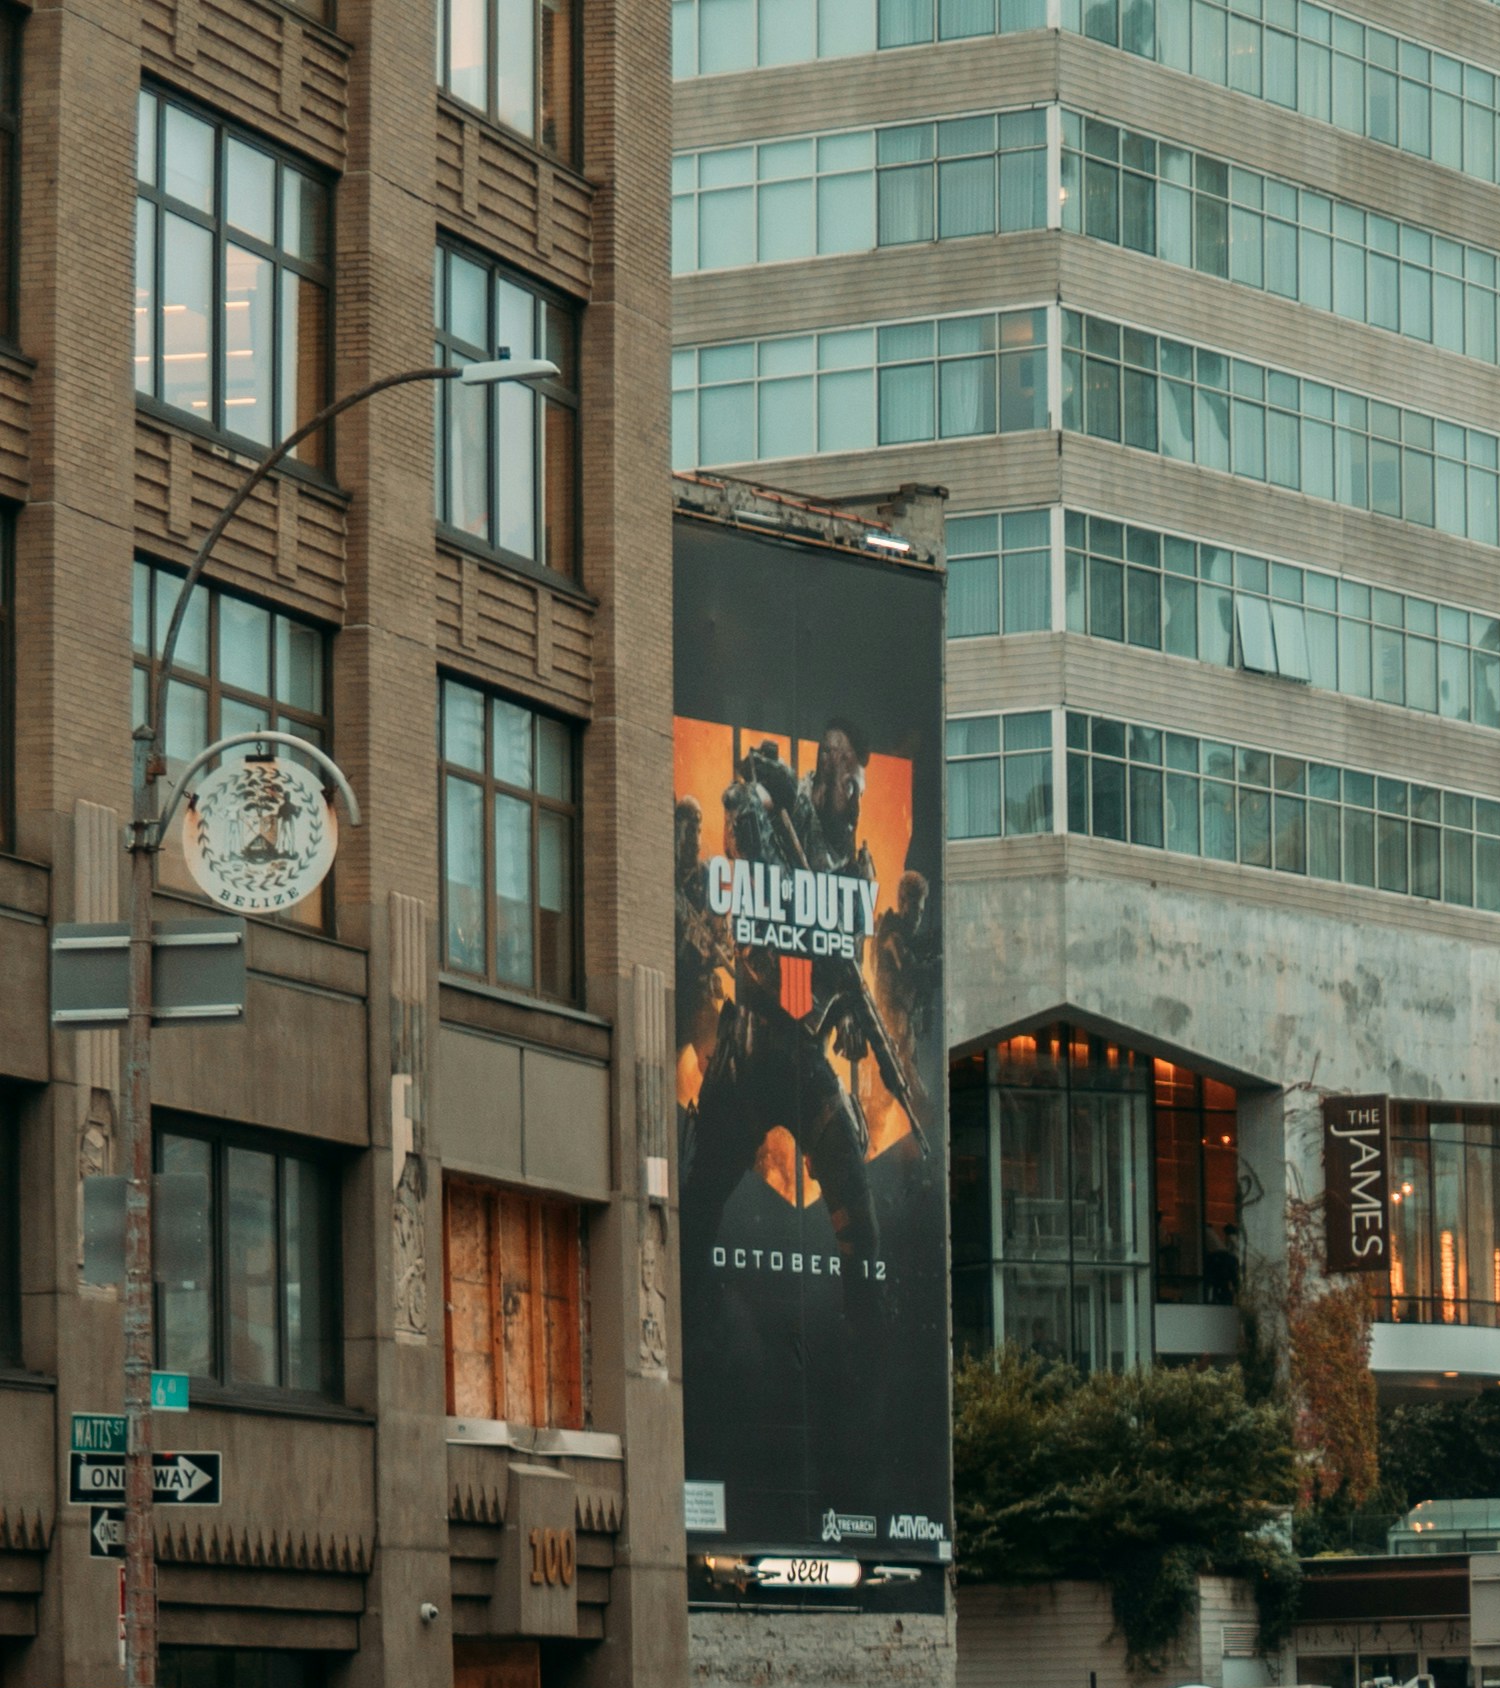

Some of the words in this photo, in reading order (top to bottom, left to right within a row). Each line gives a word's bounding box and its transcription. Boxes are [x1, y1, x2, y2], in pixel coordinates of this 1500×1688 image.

[218, 887, 299, 909] BELIZE
[709, 855, 786, 923] CALL
[781, 879, 794, 901] OF
[795, 868, 879, 936] DUTY
[736, 918, 808, 953] BLACK
[812, 930, 855, 960] OPS
[1348, 1108, 1380, 1125] THE
[1330, 1124, 1384, 1257] JAMES
[713, 1246, 842, 1277] OCTOBER
[862, 1259, 887, 1281] 12
[75, 1418, 113, 1449] WATTS
[114, 1419, 124, 1435] ST
[154, 1468, 197, 1489] WAY
[100, 1522, 118, 1543] ONE
[836, 1519, 875, 1534] TREYARCH
[889, 1514, 945, 1541] ACTIVISION
[529, 1528, 574, 1587] 100
[787, 1558, 831, 1584] seen
